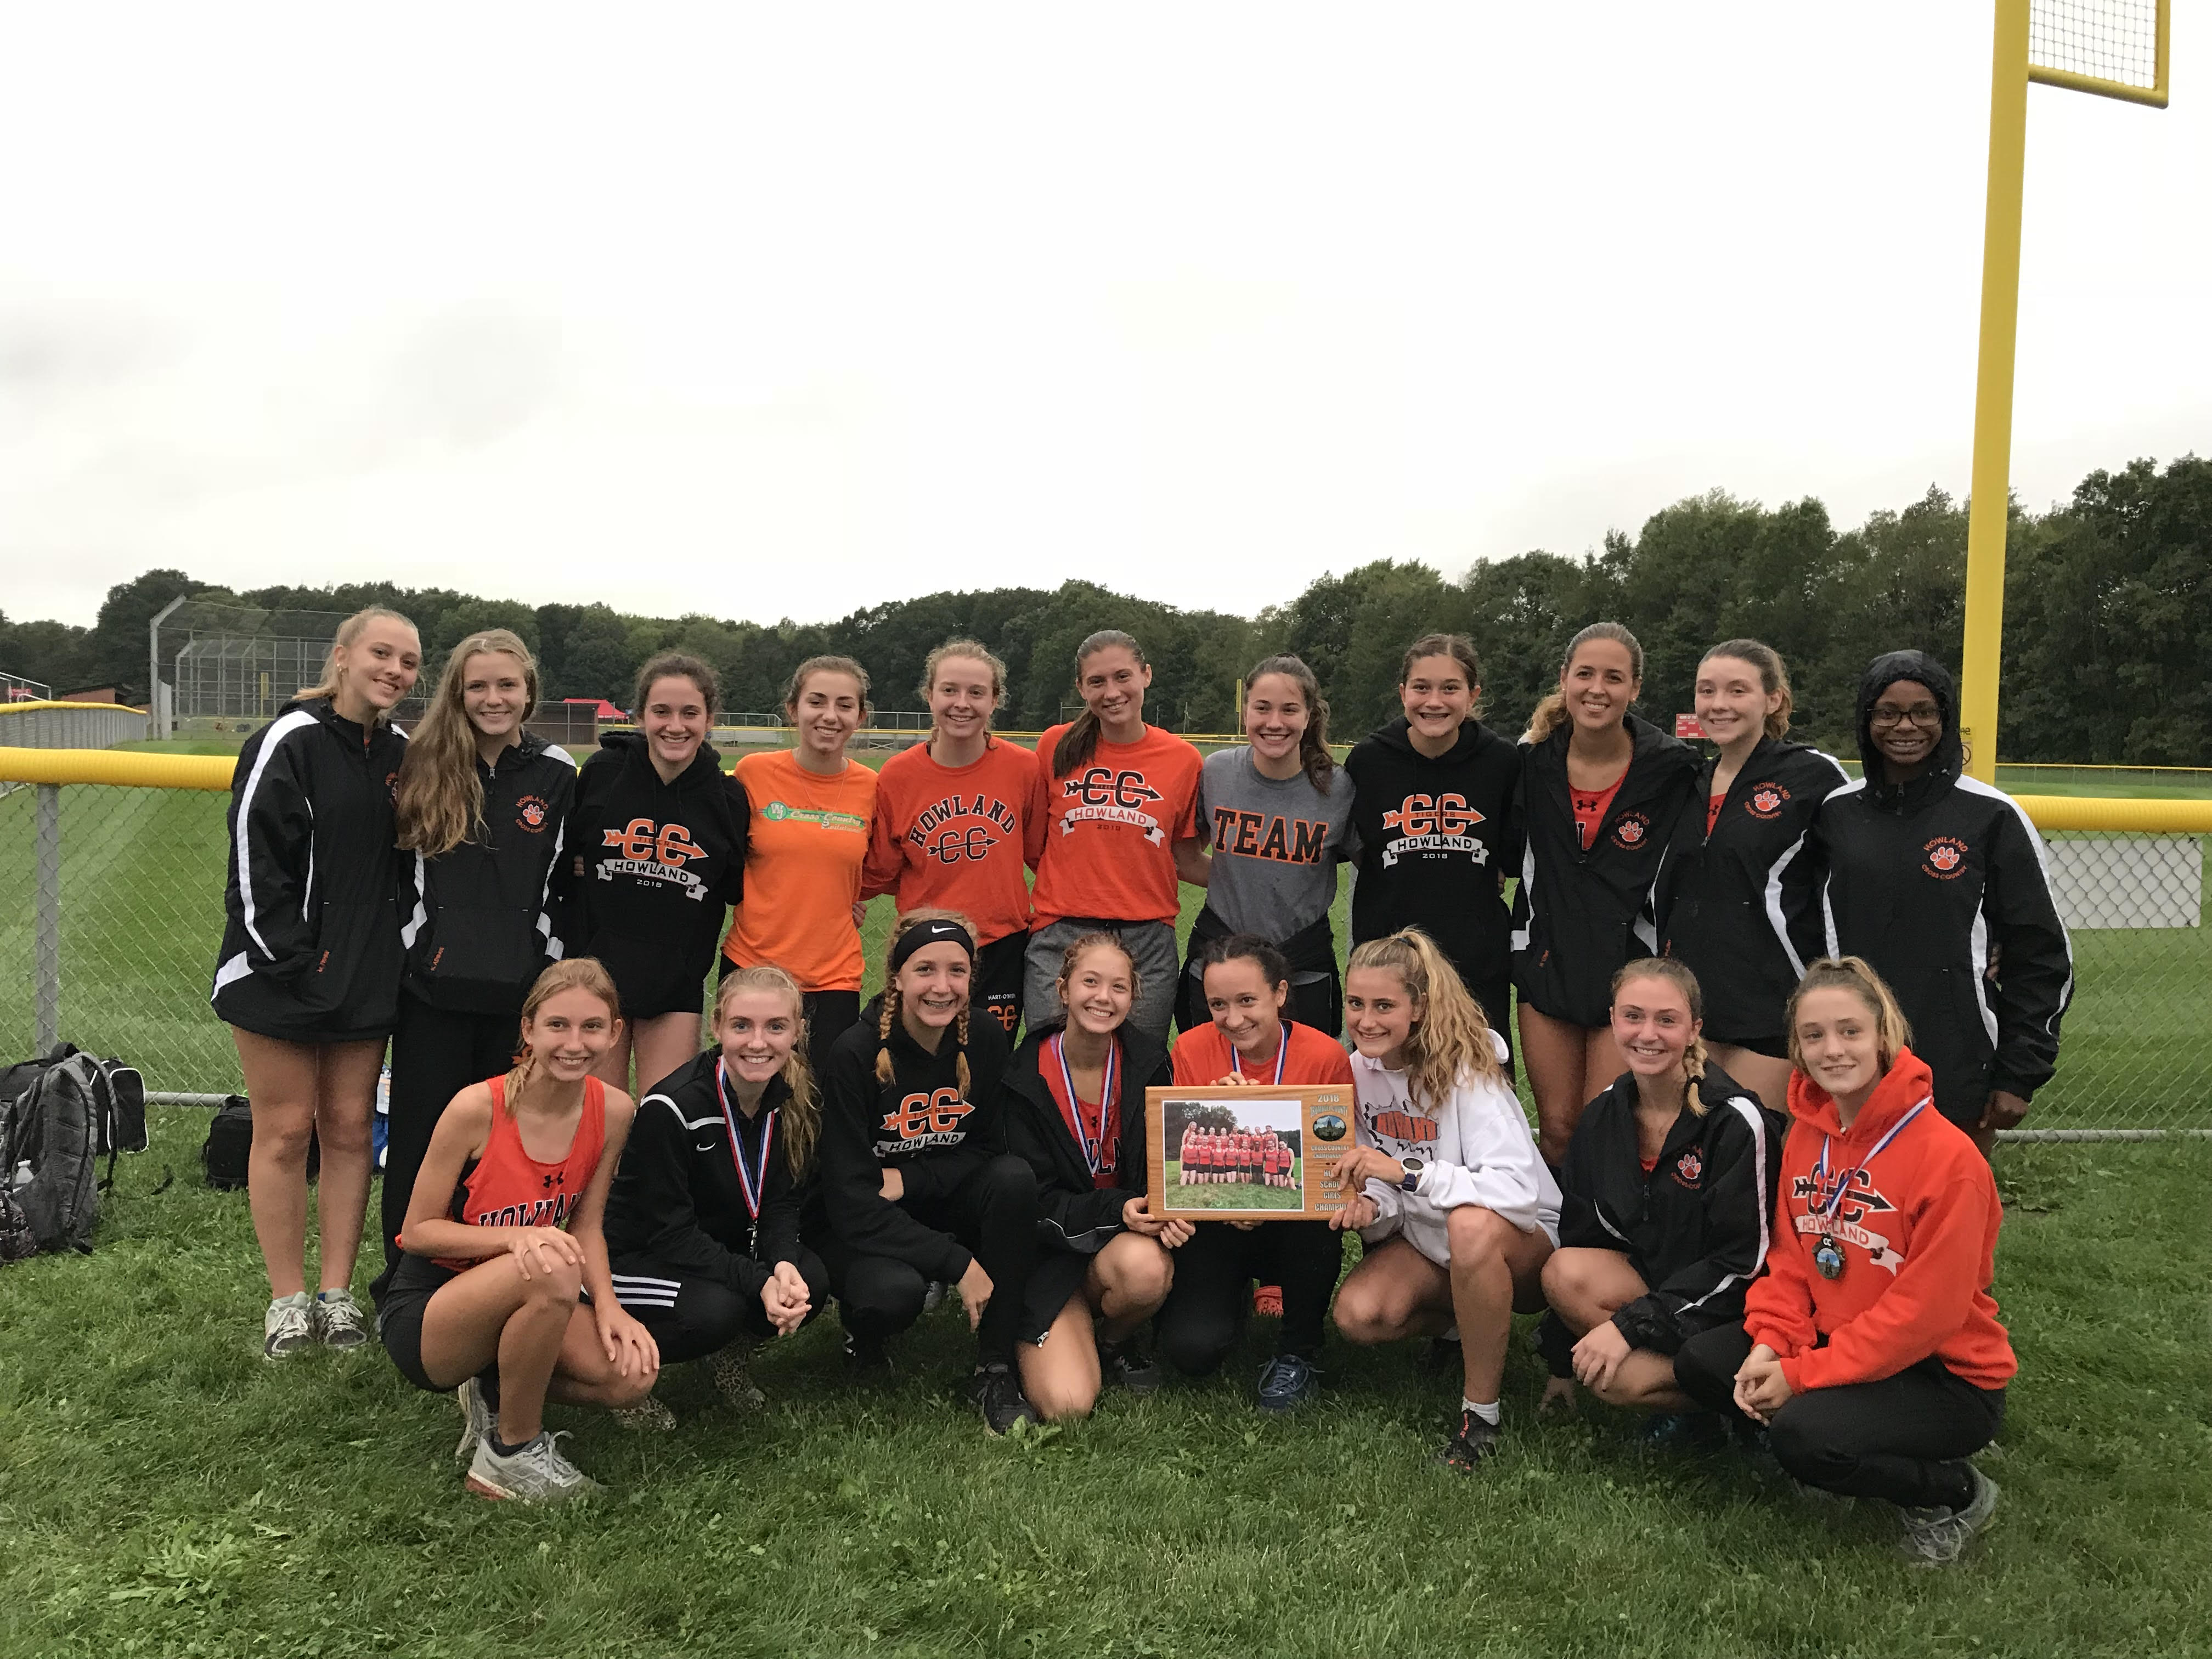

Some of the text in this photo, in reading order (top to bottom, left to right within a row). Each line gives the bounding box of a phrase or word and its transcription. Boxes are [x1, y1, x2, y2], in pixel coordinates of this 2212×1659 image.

[1081, 767, 1144, 809] CC
[1753, 782, 1791, 799] HOWLAND
[516, 795, 549, 810] HOWLAND
[791, 810, 820, 820] Cross
[909, 794, 1015, 849] HOWLAND
[1075, 808, 1147, 824] HOWLAND
[1401, 793, 1466, 836] CC
[1615, 811, 1650, 825] HOWLAND
[623, 818, 690, 867] CC
[1214, 806, 1329, 865] TEAM
[1398, 837, 1472, 850] HOWLAND
[1923, 837, 1968, 851] HOWLAND
[939, 826, 988, 865] CC
[614, 861, 689, 883] HOWLAND
[1922, 864, 1939, 878] CROSS
[636, 879, 662, 888] 2018
[1318, 1094, 1339, 1102] 2018
[900, 1087, 958, 1139] CC
[890, 1134, 958, 1151] HOWLAND
[1803, 1218, 1869, 1244] HOWLAND
